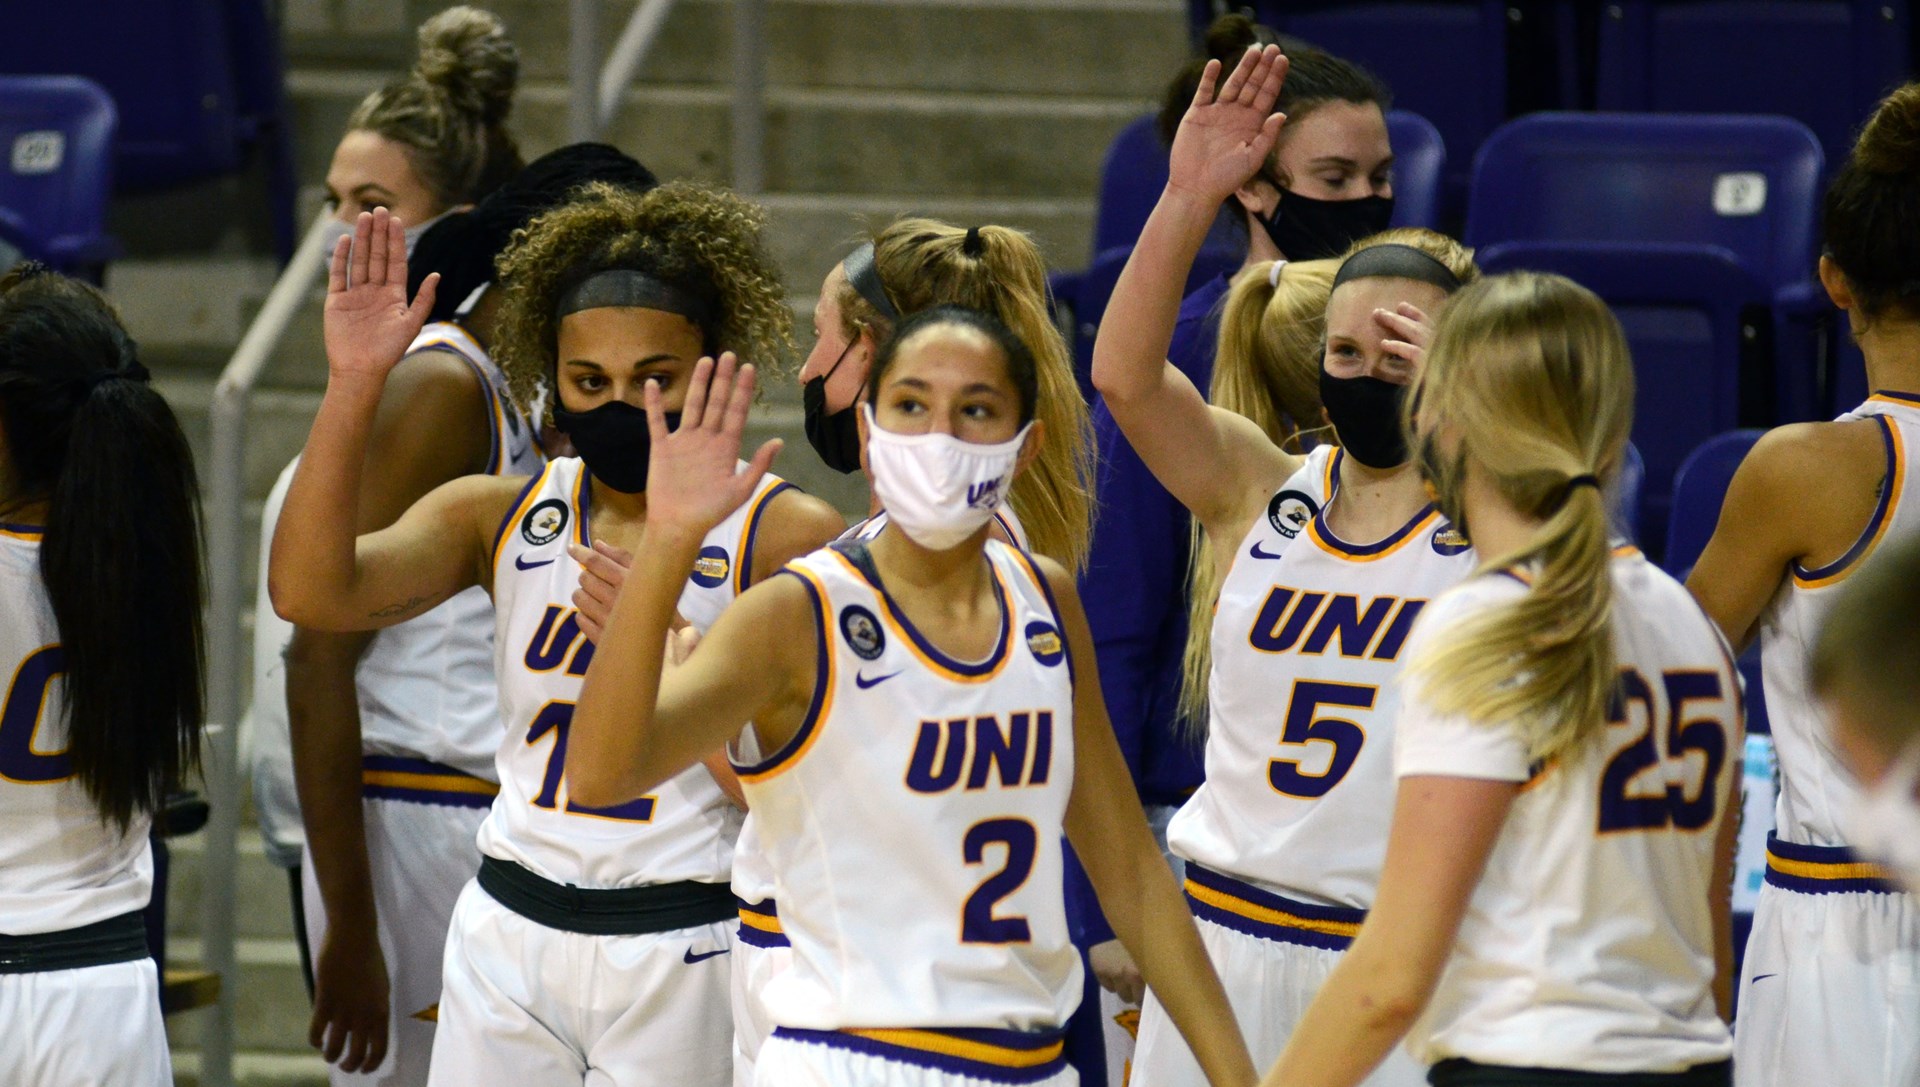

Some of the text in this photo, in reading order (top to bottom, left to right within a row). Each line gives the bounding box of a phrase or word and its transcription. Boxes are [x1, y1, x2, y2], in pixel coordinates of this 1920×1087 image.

[1248, 584, 1430, 662] UNI
[525, 698, 659, 824] 1
[903, 710, 1053, 794] UNI
[1266, 678, 1380, 800] 5
[1596, 664, 1726, 836] 25
[960, 815, 1039, 945] 2
